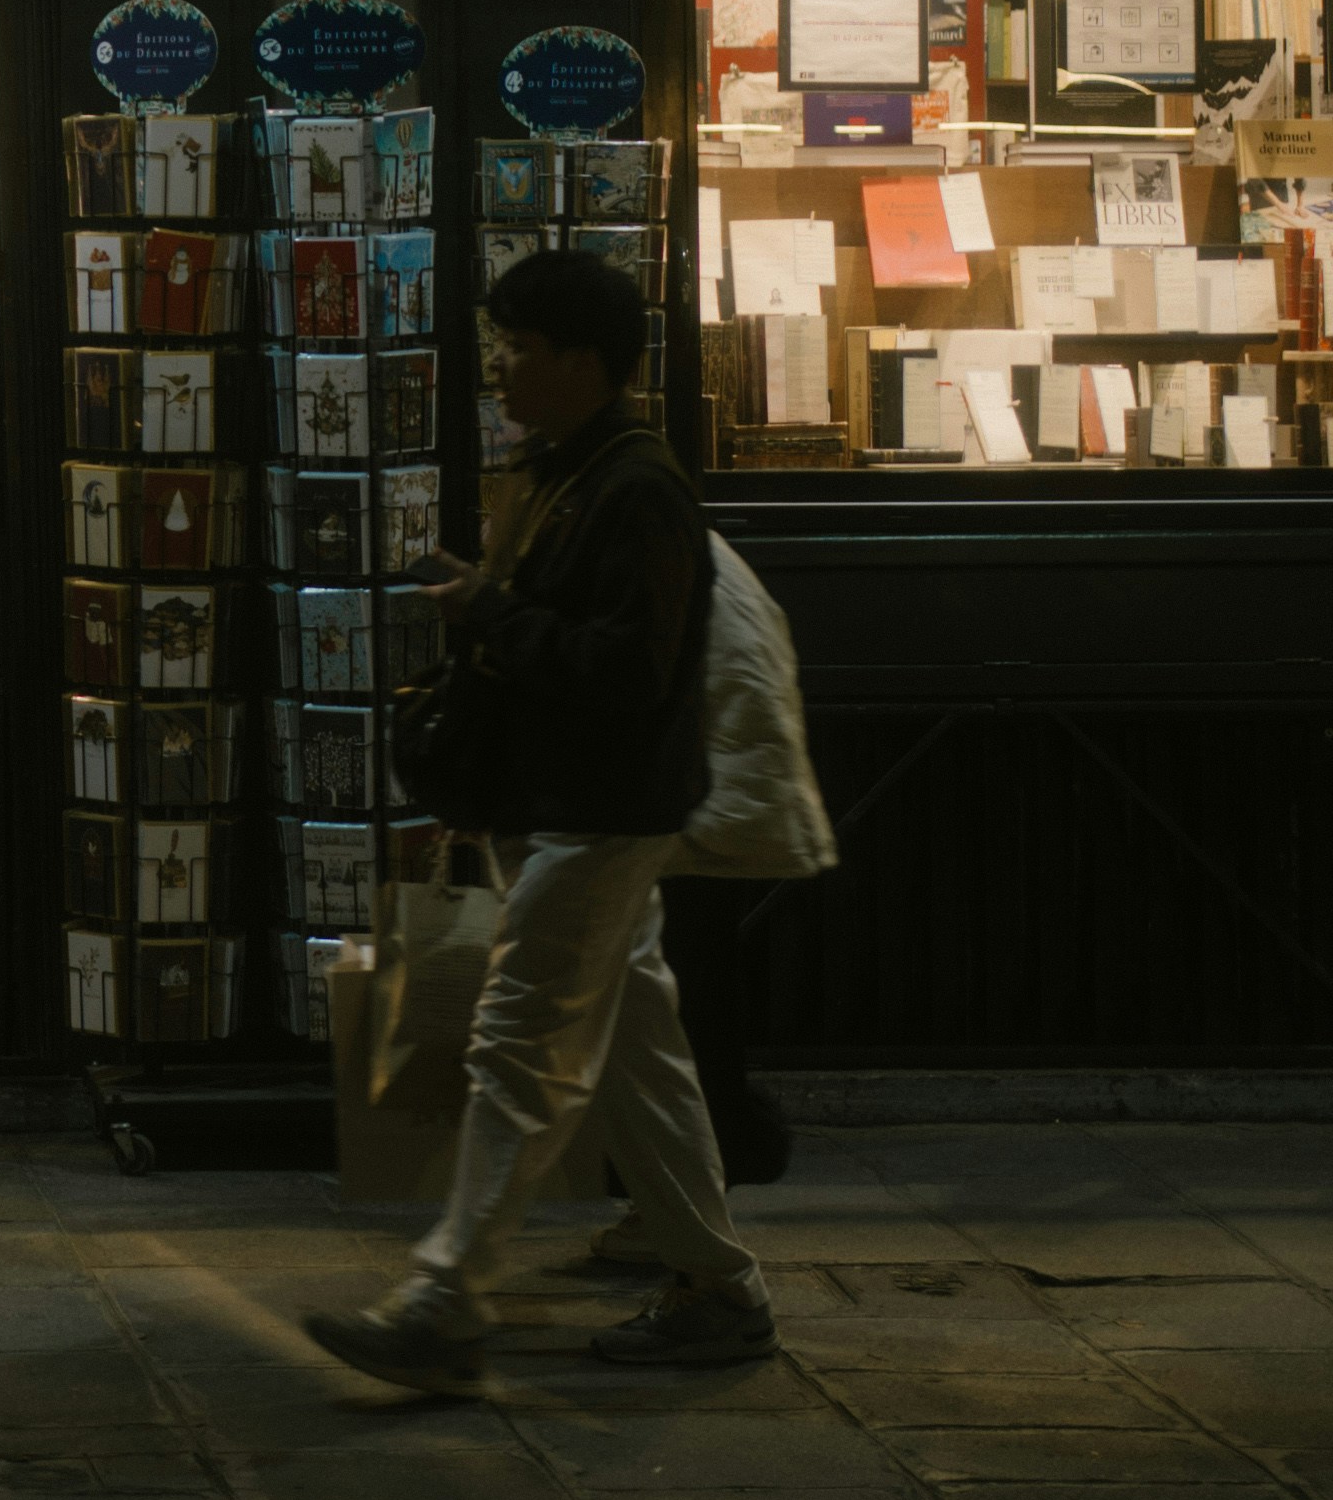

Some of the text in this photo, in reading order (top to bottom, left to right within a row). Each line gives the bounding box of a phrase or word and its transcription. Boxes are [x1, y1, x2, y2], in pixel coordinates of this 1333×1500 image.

[136, 32, 191, 44] ÉDITIONS
[313, 28, 388, 41] ÉDITIONS
[116, 47, 190, 58] DU DÉSASTRE
[287, 43, 388, 55] DU DÉSASTRE
[551, 62, 614, 74] ÉDITIONS
[527, 77, 613, 89] DU DÉSASTRE
[1263, 131, 1312, 143] Manuel
[1259, 144, 1317, 155] de reliure
[1101, 182, 1132, 204] EX
[1103, 204, 1178, 226] LIBRIS
